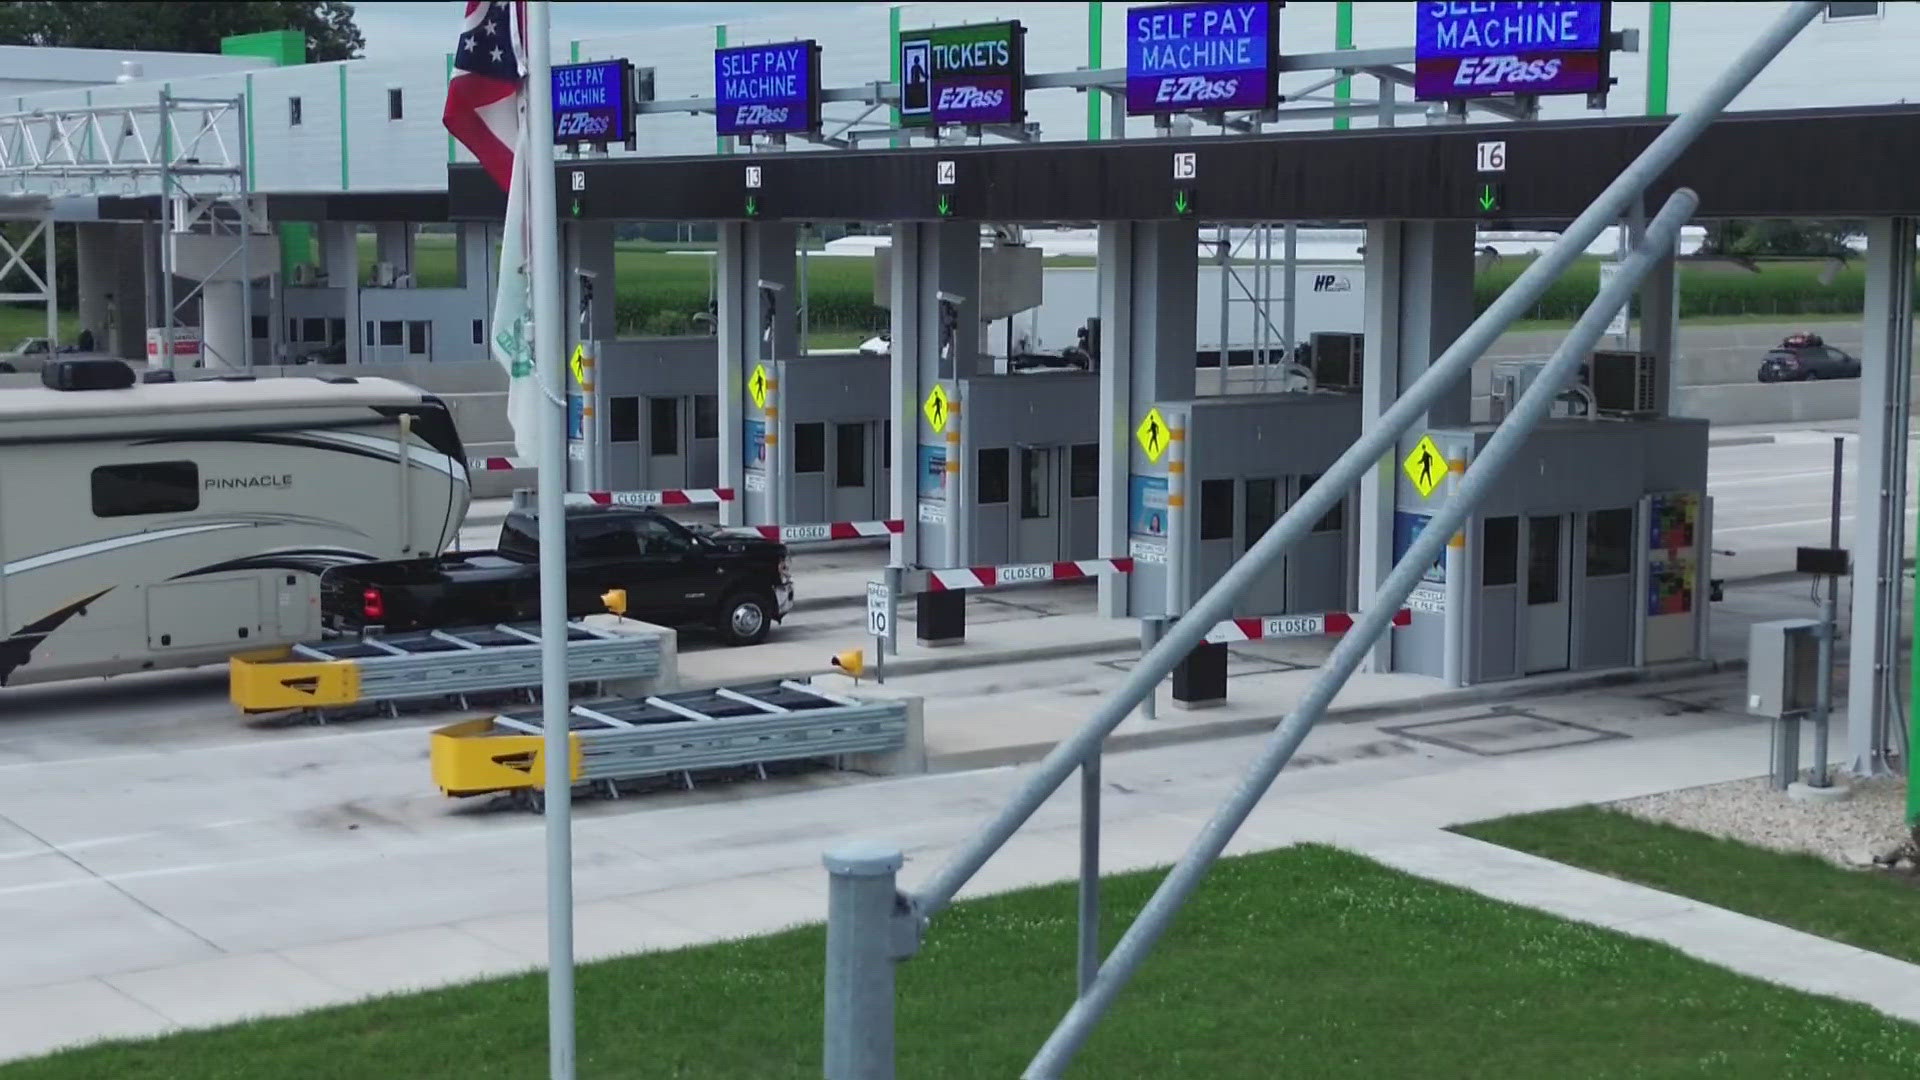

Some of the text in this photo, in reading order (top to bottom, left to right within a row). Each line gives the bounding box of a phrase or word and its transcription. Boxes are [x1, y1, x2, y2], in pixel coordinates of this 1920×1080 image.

[1138, 5, 1256, 42] SELF PAY
[1437, 10, 1578, 50] MACHINE
[722, 49, 799, 77] SELF PAY
[932, 39, 1009, 70] TICKETS
[1142, 37, 1251, 71] MACHINE
[559, 66, 605, 87] SELF PAY
[559, 87, 606, 106] MACHINE
[725, 75, 797, 100] MACHINE
[1175, 155, 1195, 177] 15
[1479, 145, 1504, 169] 16
[573, 173, 584, 189] 12
[747, 168, 761, 186] 13
[938, 163, 955, 183] 14
[1313, 274, 1336, 291] HP
[205, 474, 292, 490] PINNACLE
[786, 526, 825, 538] CLOSED
[1003, 566, 1046, 580] CLOSED
[871, 611, 886, 632] 10
[1270, 619, 1317, 634] CLOSED
